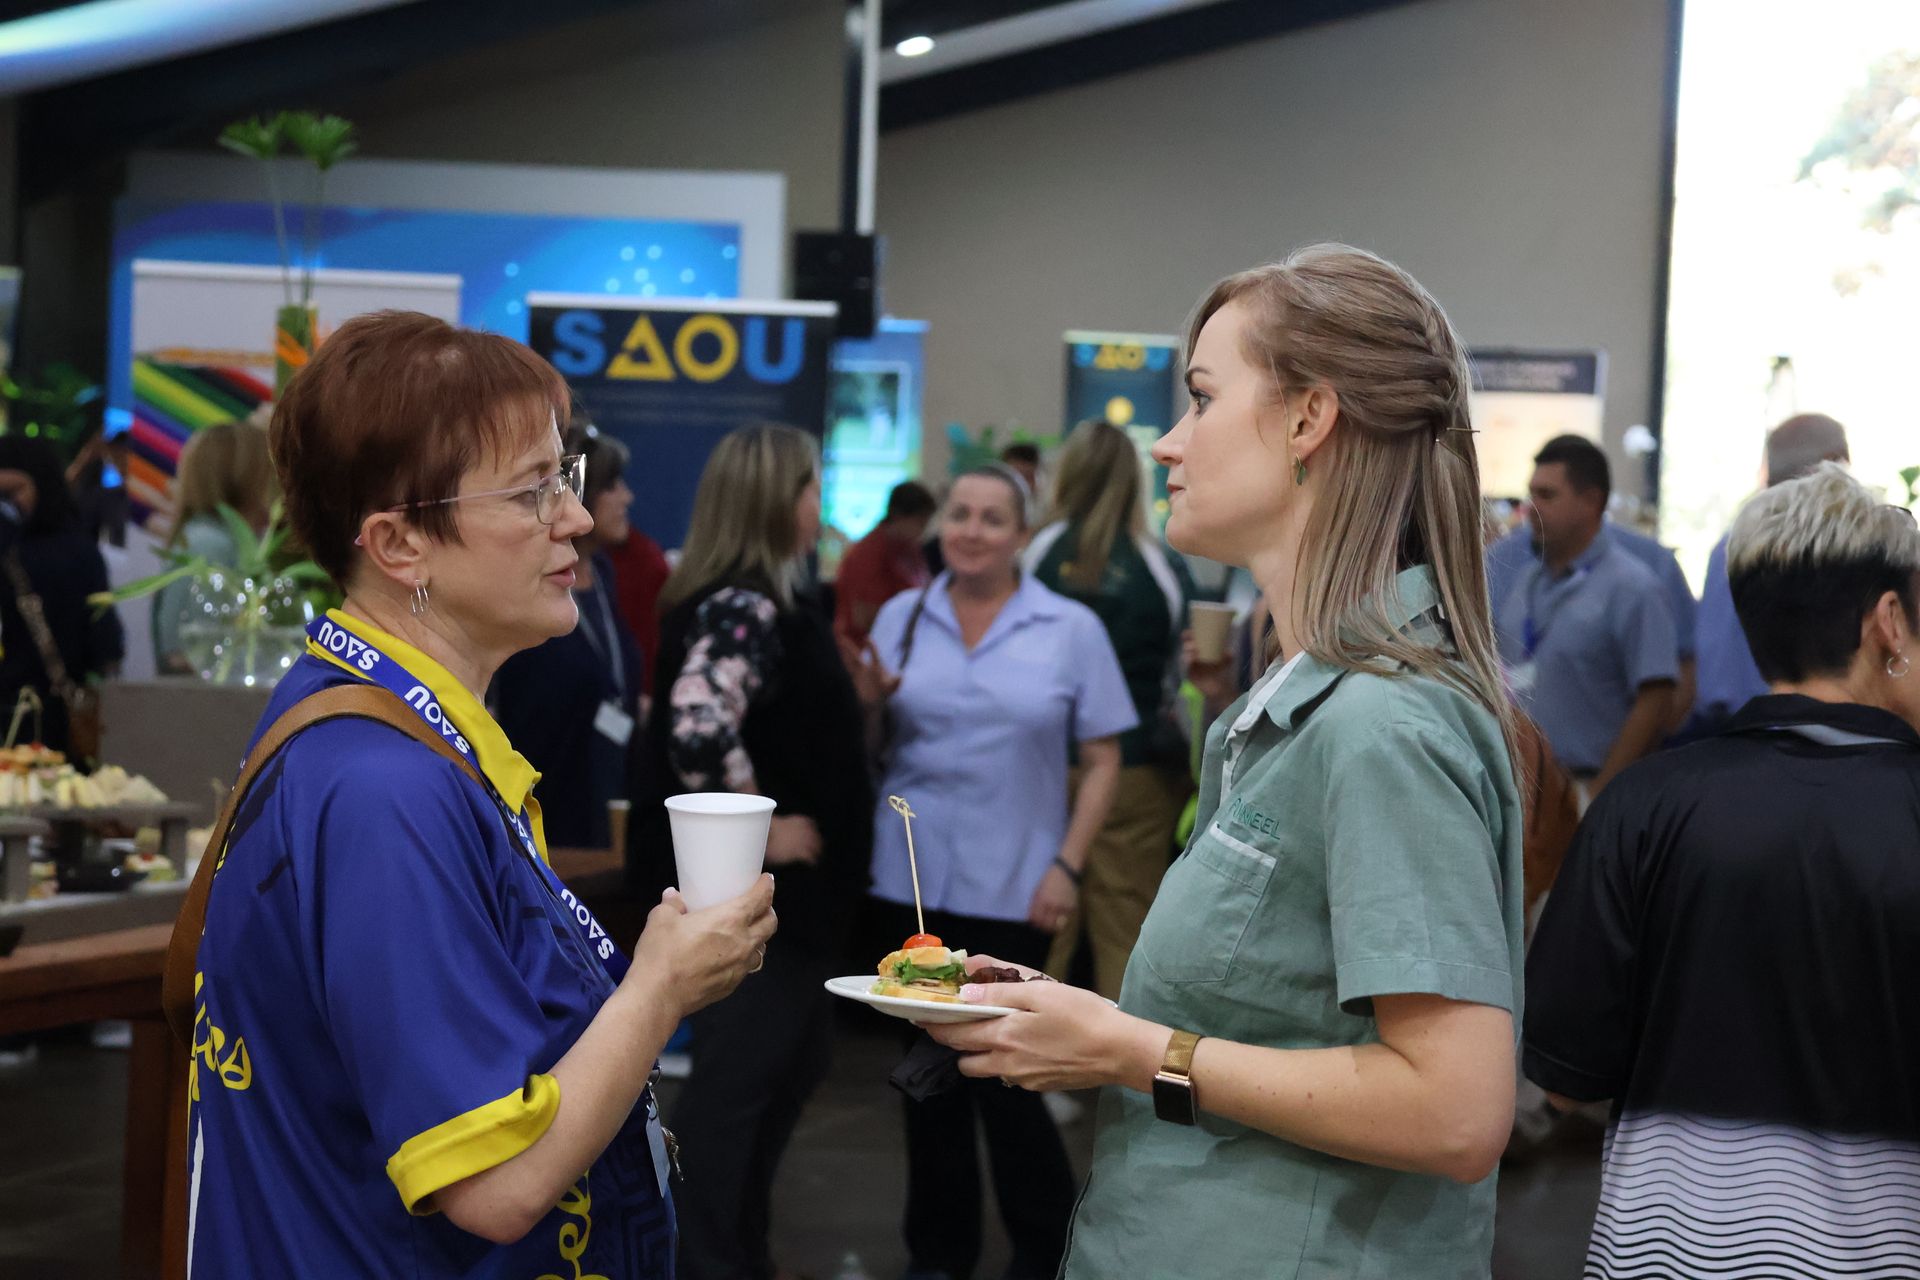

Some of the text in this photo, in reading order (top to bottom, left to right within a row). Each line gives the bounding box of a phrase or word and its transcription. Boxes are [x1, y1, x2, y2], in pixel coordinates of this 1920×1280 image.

[552, 310, 805, 384] SAOU
[318, 621, 380, 671] SAOU
[404, 685, 471, 754] SAOU
[560, 887, 615, 960] SAOU
